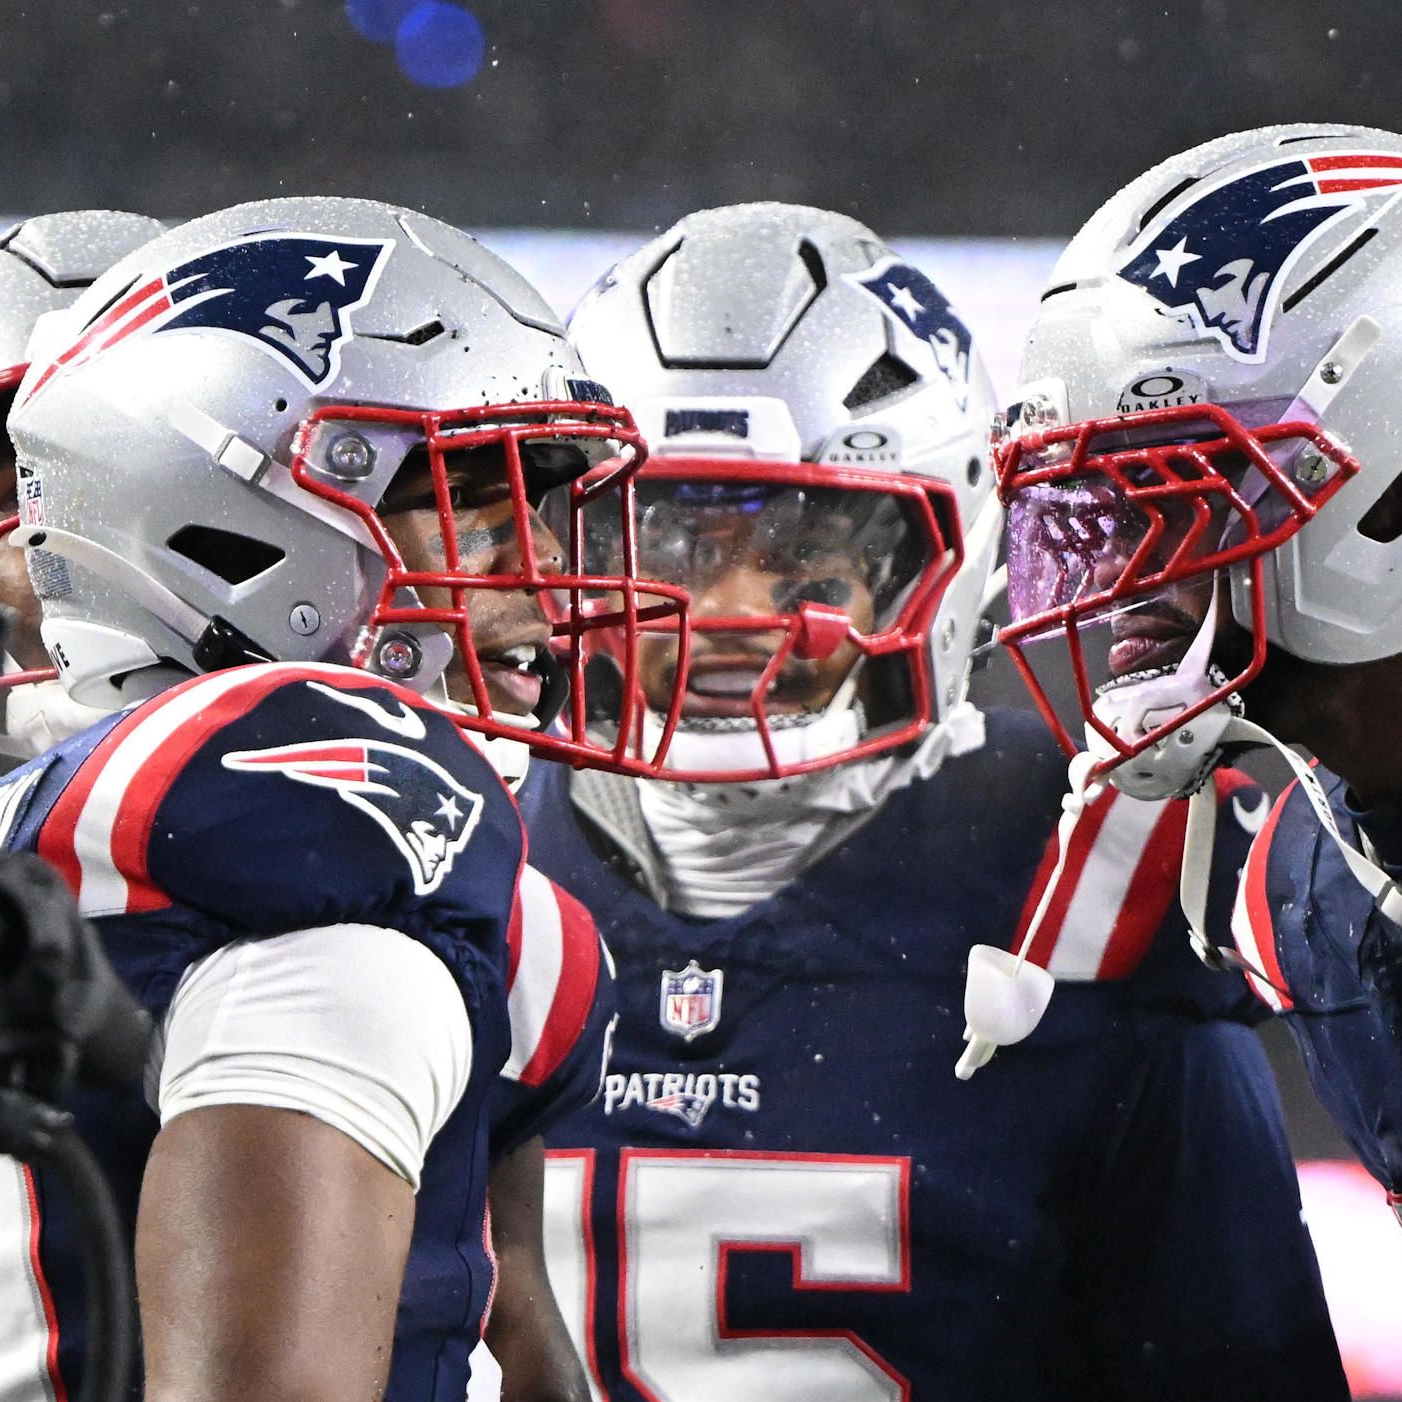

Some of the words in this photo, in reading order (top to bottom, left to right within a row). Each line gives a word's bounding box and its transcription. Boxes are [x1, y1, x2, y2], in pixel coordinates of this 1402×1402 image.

[1121, 394, 1199, 414] OAKLEY
[671, 996, 711, 1025] NFL
[603, 1073, 761, 1116] PATRIOTS
